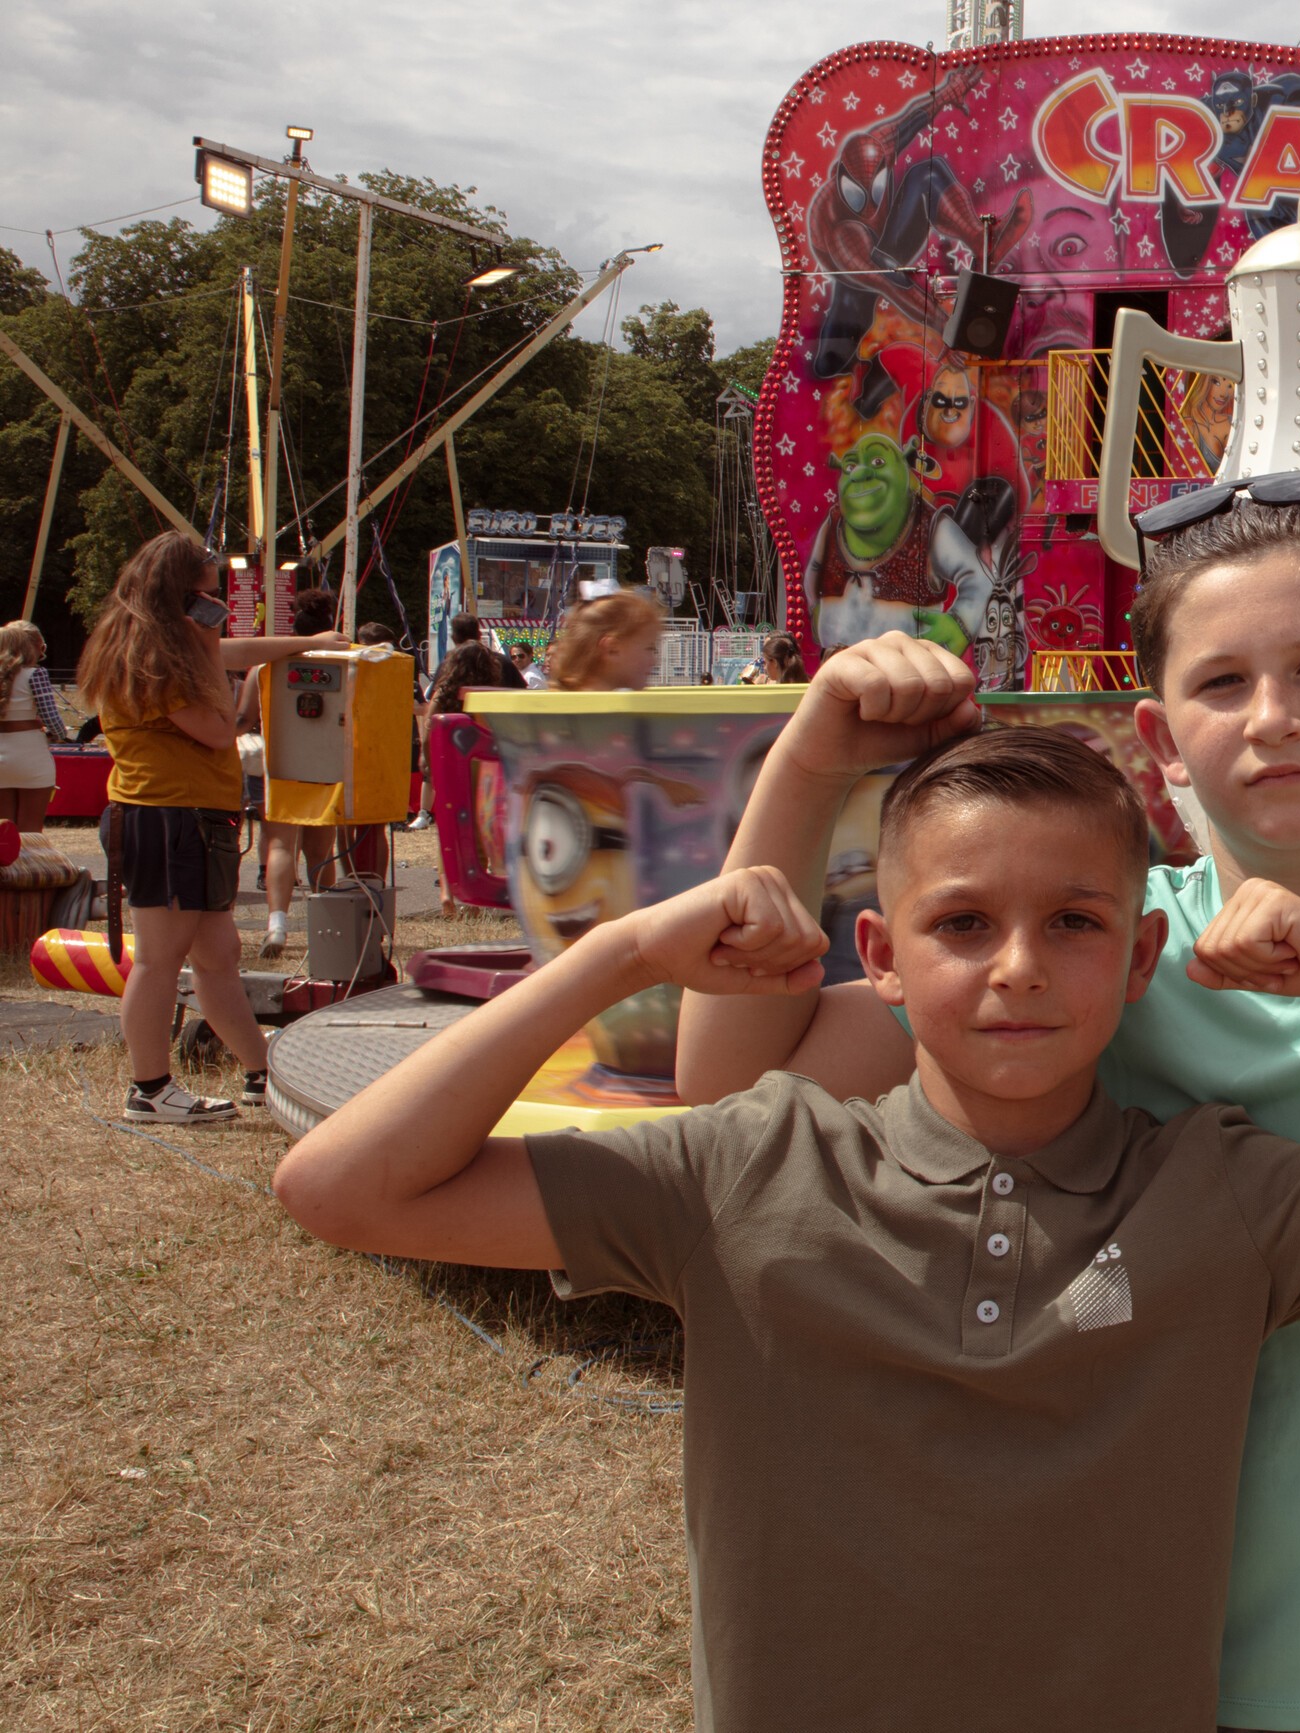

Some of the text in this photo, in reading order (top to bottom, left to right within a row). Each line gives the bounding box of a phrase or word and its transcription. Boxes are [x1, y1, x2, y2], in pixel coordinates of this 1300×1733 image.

[1081, 484, 1159, 508] FN!
[467, 508, 627, 540] EURO FLYER
